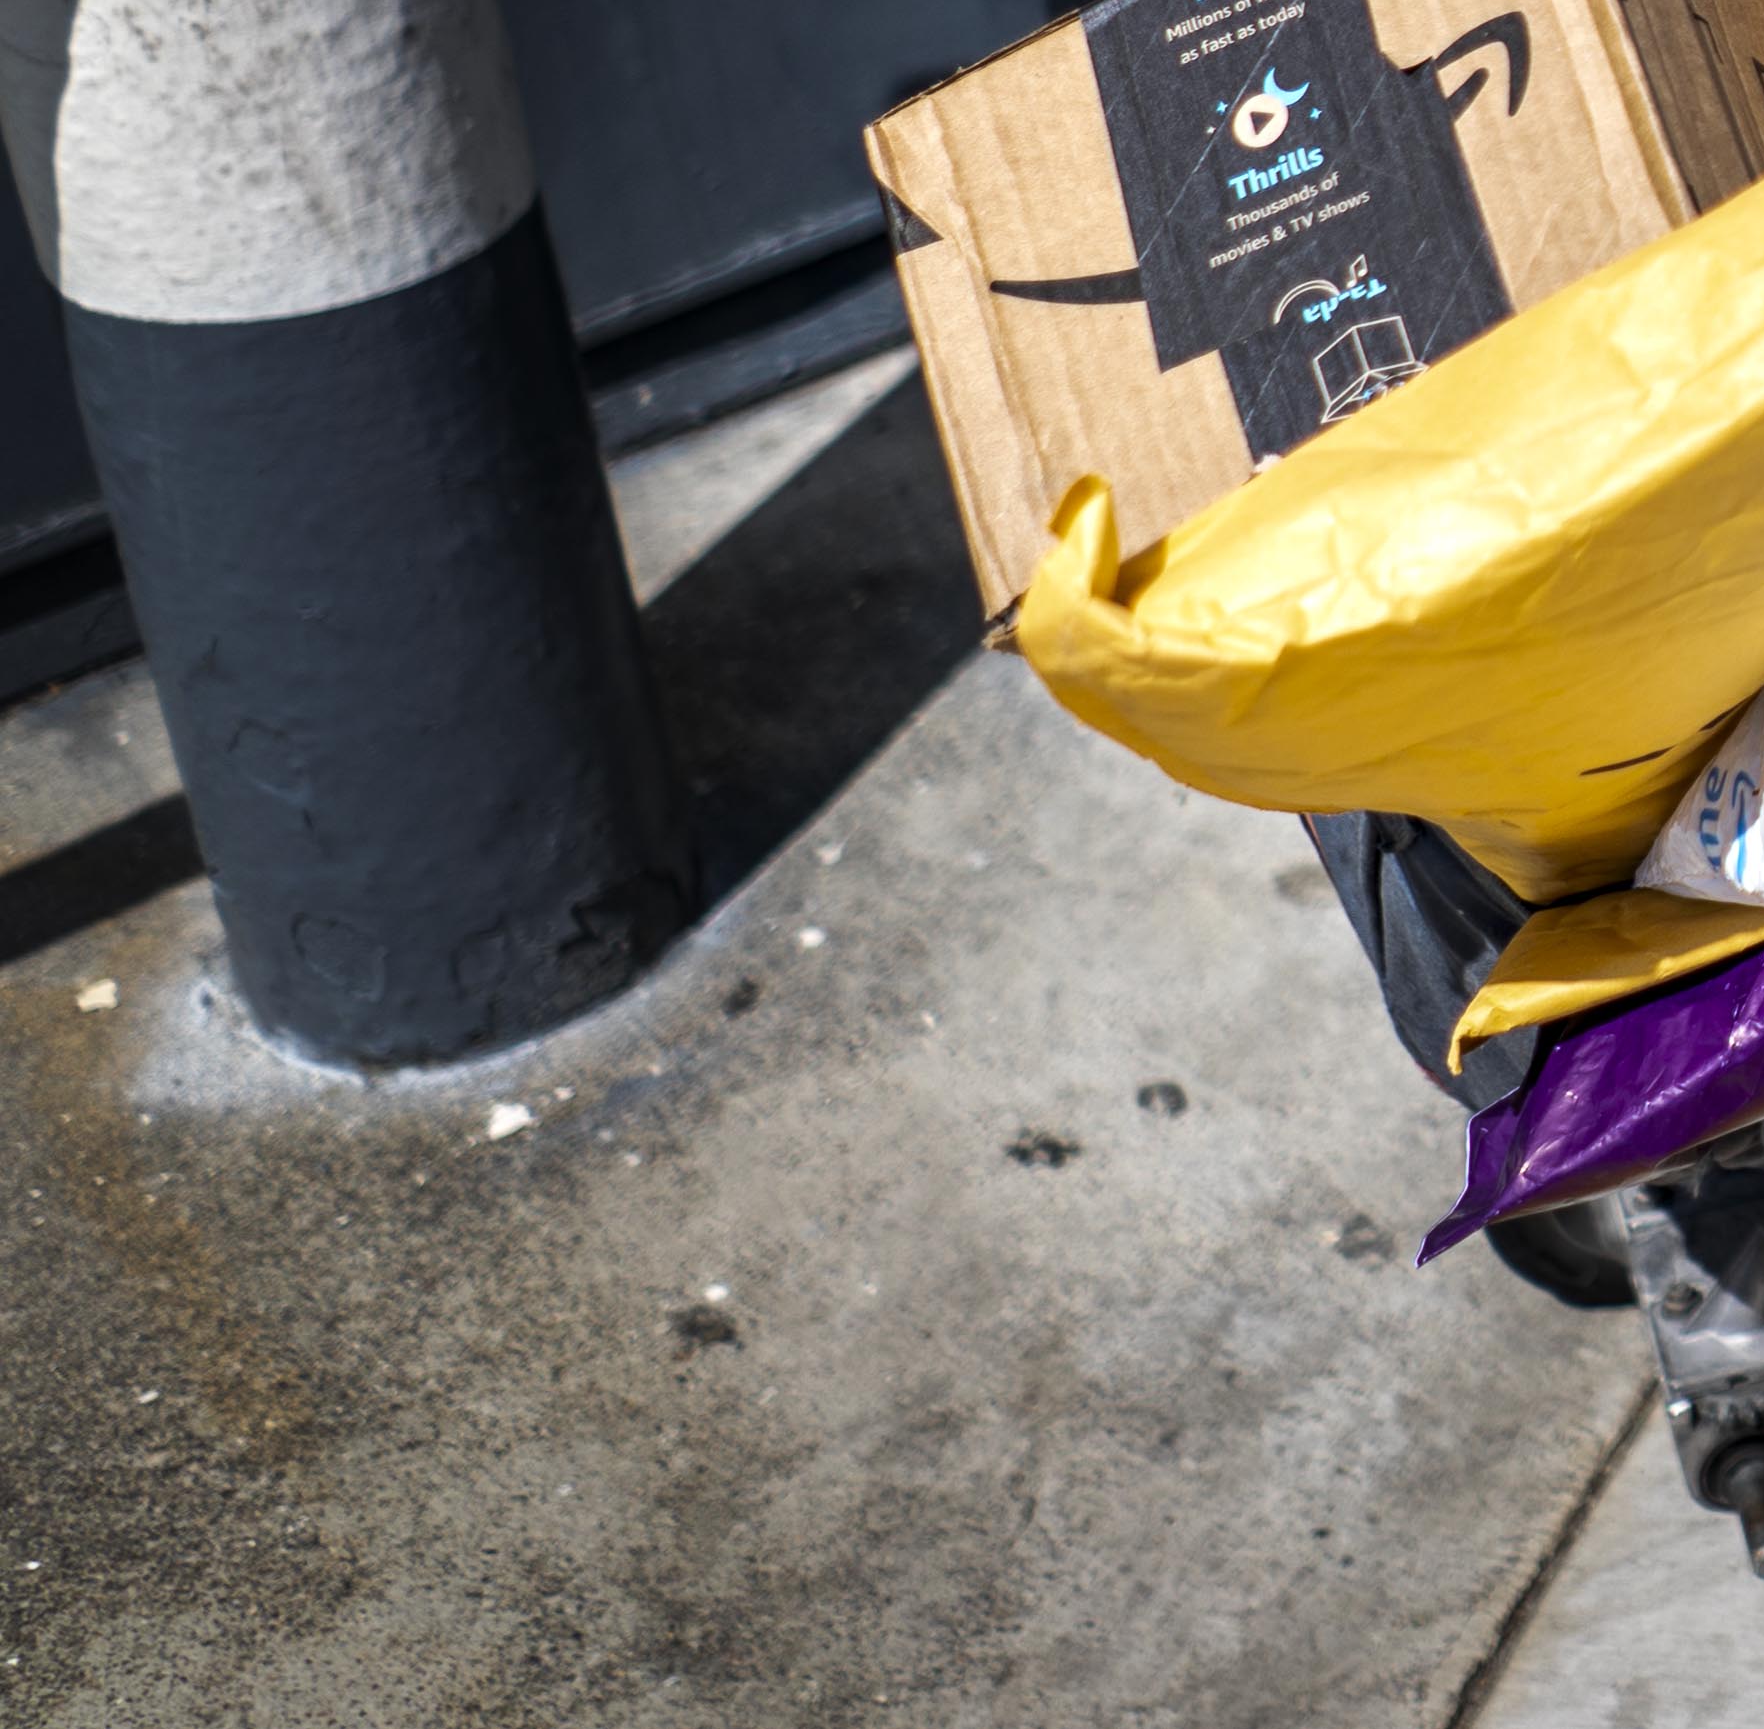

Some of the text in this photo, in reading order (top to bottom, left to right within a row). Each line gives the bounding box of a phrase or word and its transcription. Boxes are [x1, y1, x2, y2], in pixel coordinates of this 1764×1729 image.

[1165, 5, 1232, 43] Millions
[1180, 1, 1306, 65] as fast as today
[1226, 171, 1340, 231] Thousands of
[1227, 146, 1325, 200] Thrills
[1209, 190, 1371, 269] movies & TV shows
